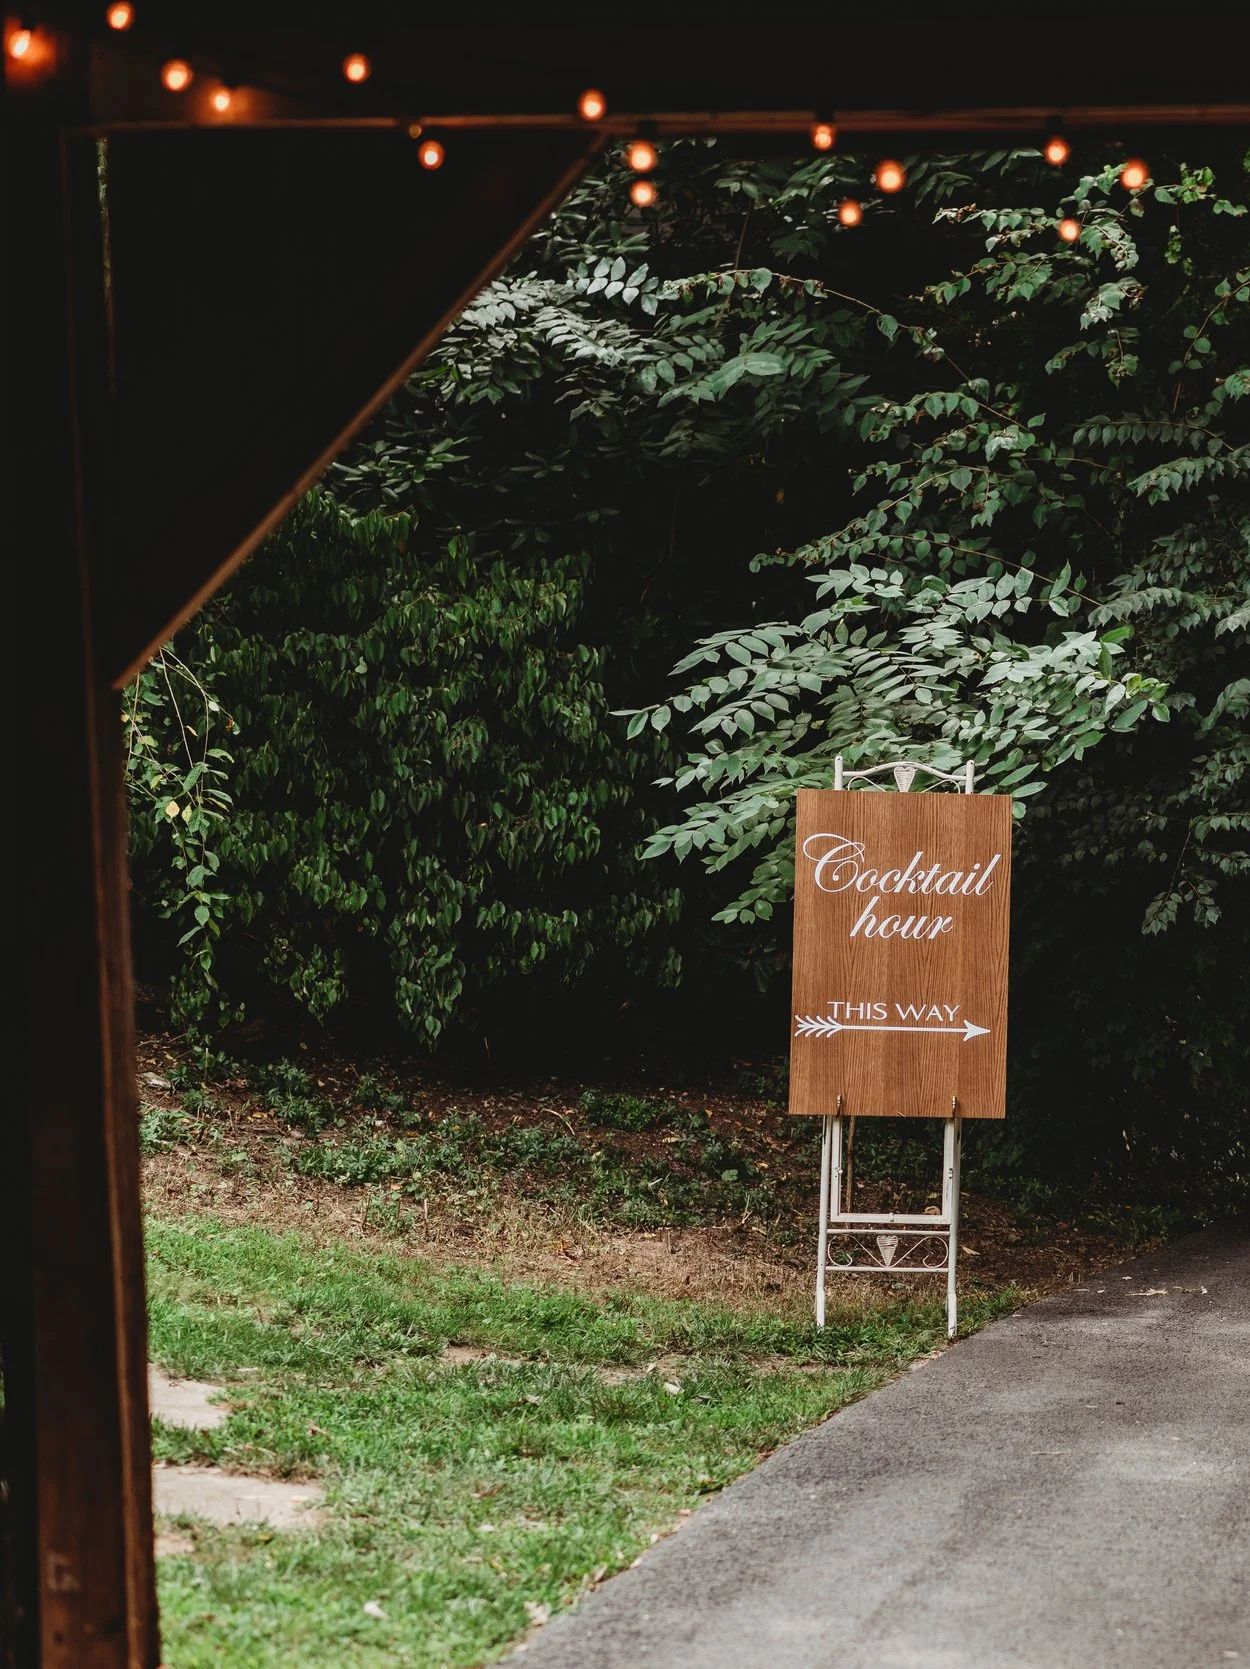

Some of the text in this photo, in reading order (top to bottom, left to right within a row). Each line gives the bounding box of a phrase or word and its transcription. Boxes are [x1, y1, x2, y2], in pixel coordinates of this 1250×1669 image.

[802, 832, 1002, 896] Cocktail
[849, 895, 953, 940] hour
[827, 1001, 960, 1022] THIS WAY
